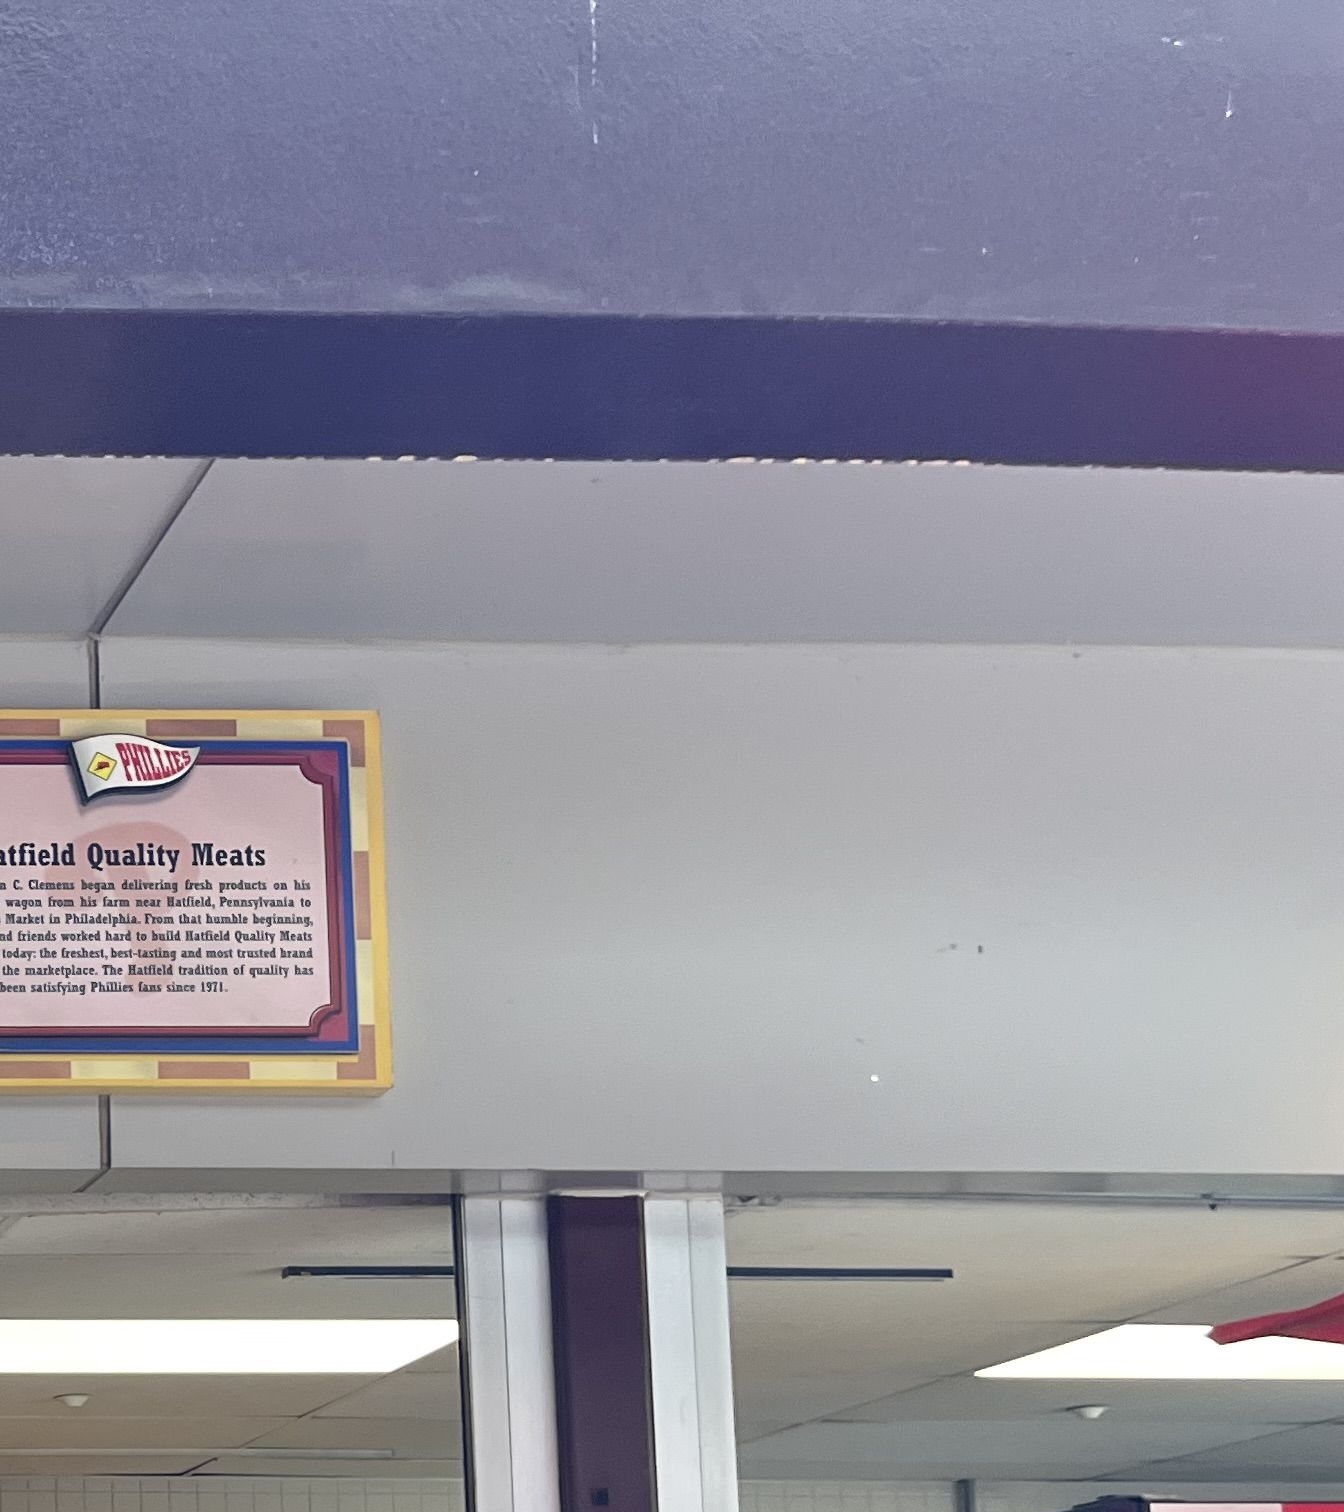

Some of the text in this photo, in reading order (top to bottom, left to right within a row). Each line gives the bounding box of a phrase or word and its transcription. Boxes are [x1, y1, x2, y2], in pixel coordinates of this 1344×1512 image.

[115, 743, 192, 782] PHILLIES
[88, 843, 180, 872] Quality
[192, 843, 266, 867] Meats
[13, 880, 22, 890] C.
[29, 880, 75, 890] Clemens
[81, 879, 115, 893] began
[121, 879, 177, 893] delivering
[185, 879, 212, 890] fresh
[219, 880, 266, 893] products
[274, 882, 287, 890] on
[294, 879, 310, 890] his
[5, 899, 42, 910] wagon
[48, 896, 74, 907] from
[80, 896, 97, 907] his
[102, 896, 129, 907] farm
[167, 896, 215, 909] Hatfield,
[219, 896, 294, 909] Pennsylvania
[301, 898, 311, 907] to
[5, 914, 44, 924] Market
[49, 914, 60, 924] in
[65, 914, 141, 927] Philadelphia.
[145, 914, 174, 924] From
[179, 914, 201, 924] that
[206, 914, 248, 924] humble
[253, 914, 313, 927] beginning,
[17, 931, 56, 941] friends
[62, 931, 100, 941] worked
[106, 931, 131, 941] hard
[136, 932, 147, 941] to
[152, 931, 181, 941] build
[186, 931, 230, 941] Hatfield
[234, 931, 275, 944] Quality
[280, 931, 312, 941] Meats
[2, 948, 36, 961] today:
[40, 948, 57, 958] the
[62, 948, 108, 960] freshest,
[111, 948, 176, 961] best-tasting
[181, 948, 201, 958] and
[206, 949, 232, 958] most
[237, 948, 276, 958] trusted
[280, 948, 313, 958] brand
[2, 965, 19, 975] the
[25, 965, 98, 978] marketplace.
[103, 965, 123, 975] The
[128, 965, 173, 975] Hatfield
[179, 965, 228, 975] tradition
[234, 965, 245, 975] of
[249, 965, 289, 978] quality
[295, 965, 313, 975] has
[0, 982, 229, 995] been satisfying Phillies fans since 1971.
